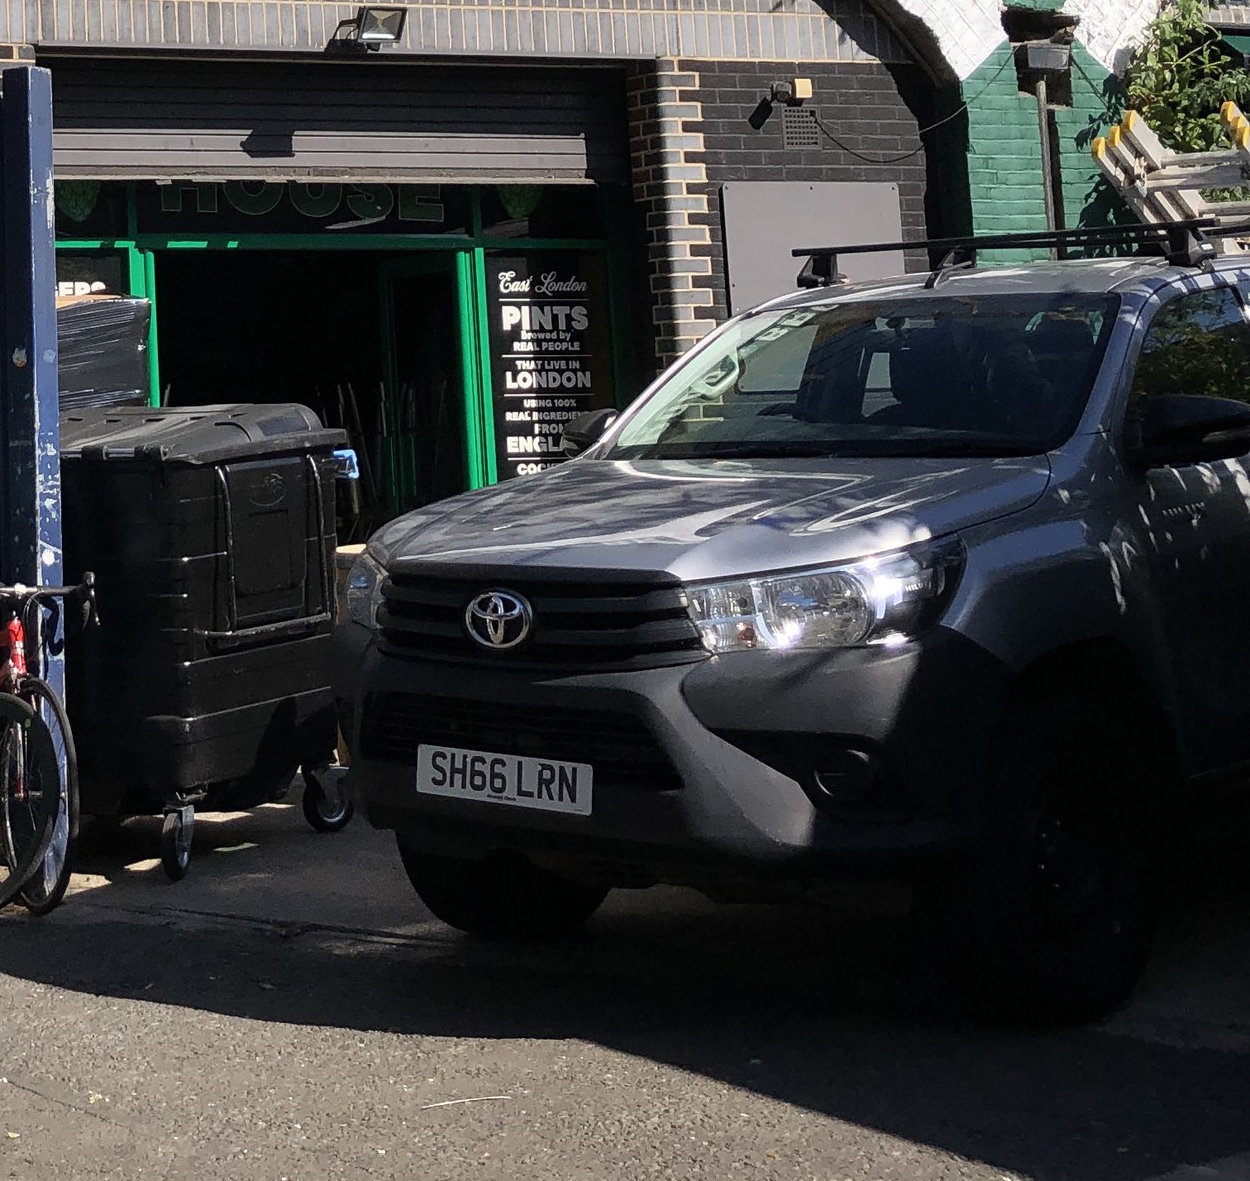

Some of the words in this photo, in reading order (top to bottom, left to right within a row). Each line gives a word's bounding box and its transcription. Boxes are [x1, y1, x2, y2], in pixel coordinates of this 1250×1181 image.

[498, 271, 533, 293] East
[534, 271, 588, 296] London
[501, 305, 589, 331] PINTS
[521, 330, 557, 340] brewed
[513, 342, 540, 352] REAL
[541, 341, 580, 351] PEOPLE
[515, 360, 542, 370] THAT
[544, 360, 567, 369] LIVE
[568, 360, 580, 369] IN
[505, 371, 592, 389] LONDON
[523, 399, 552, 408] USING
[554, 399, 577, 407] 100%
[505, 411, 532, 421] REAL
[532, 411, 590, 421] INGREDIE
[431, 751, 508, 794] SH66
[516, 760, 578, 804] LRN
